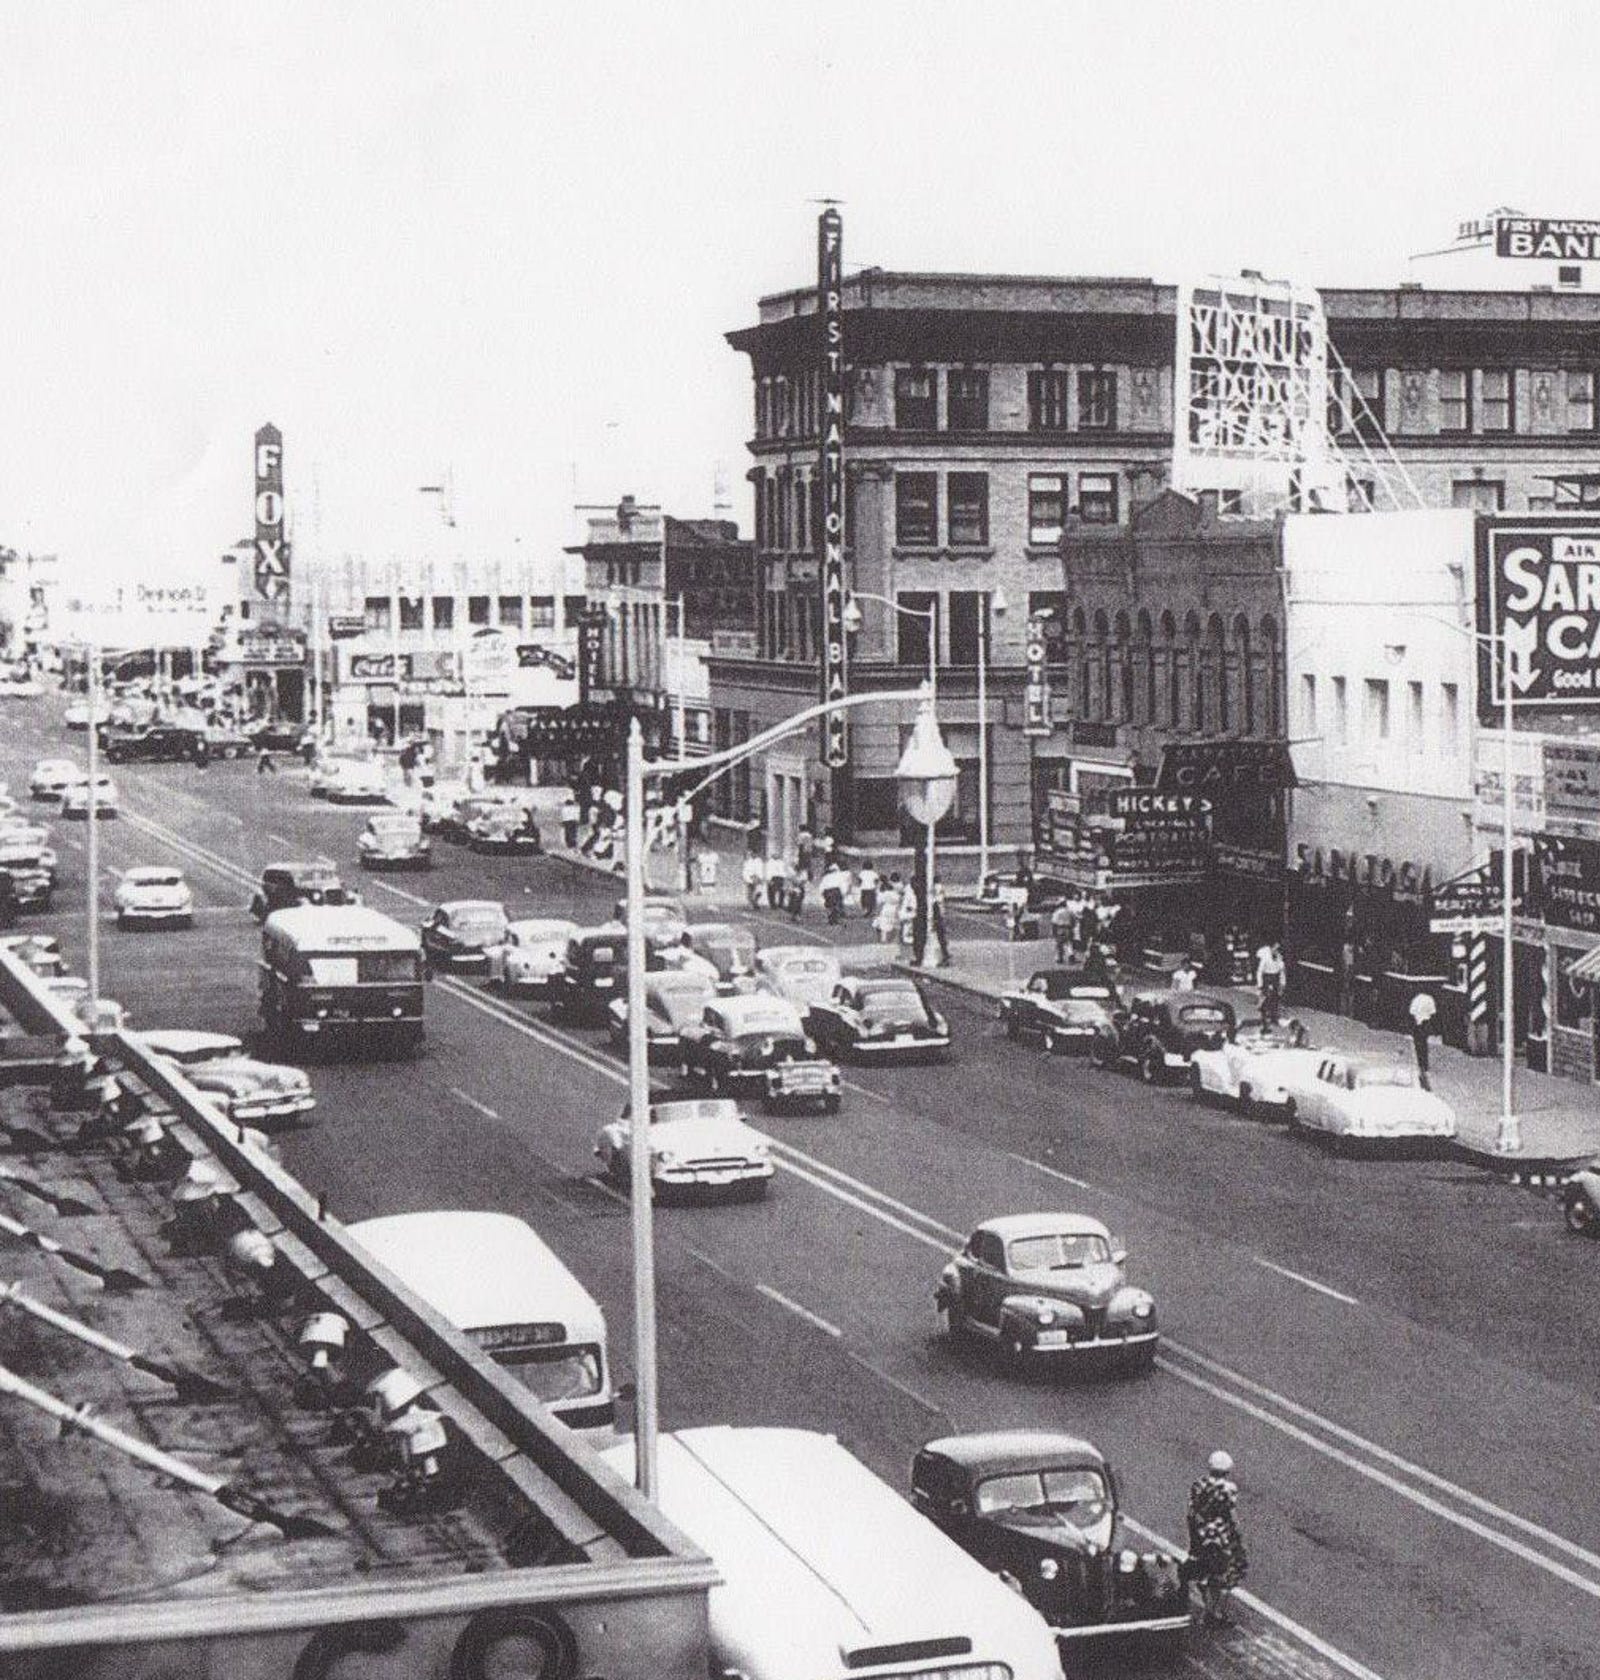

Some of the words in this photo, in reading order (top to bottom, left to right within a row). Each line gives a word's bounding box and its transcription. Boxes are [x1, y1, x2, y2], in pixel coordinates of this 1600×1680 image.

[825, 231, 842, 373] FIRST
[256, 444, 285, 575] FOX
[825, 393, 842, 624] NATIONAL
[1564, 545, 1596, 557] AIR
[1027, 622, 1045, 722] HOTEL
[1552, 669, 1592, 688] Good
[1176, 763, 1280, 786] CAFE
